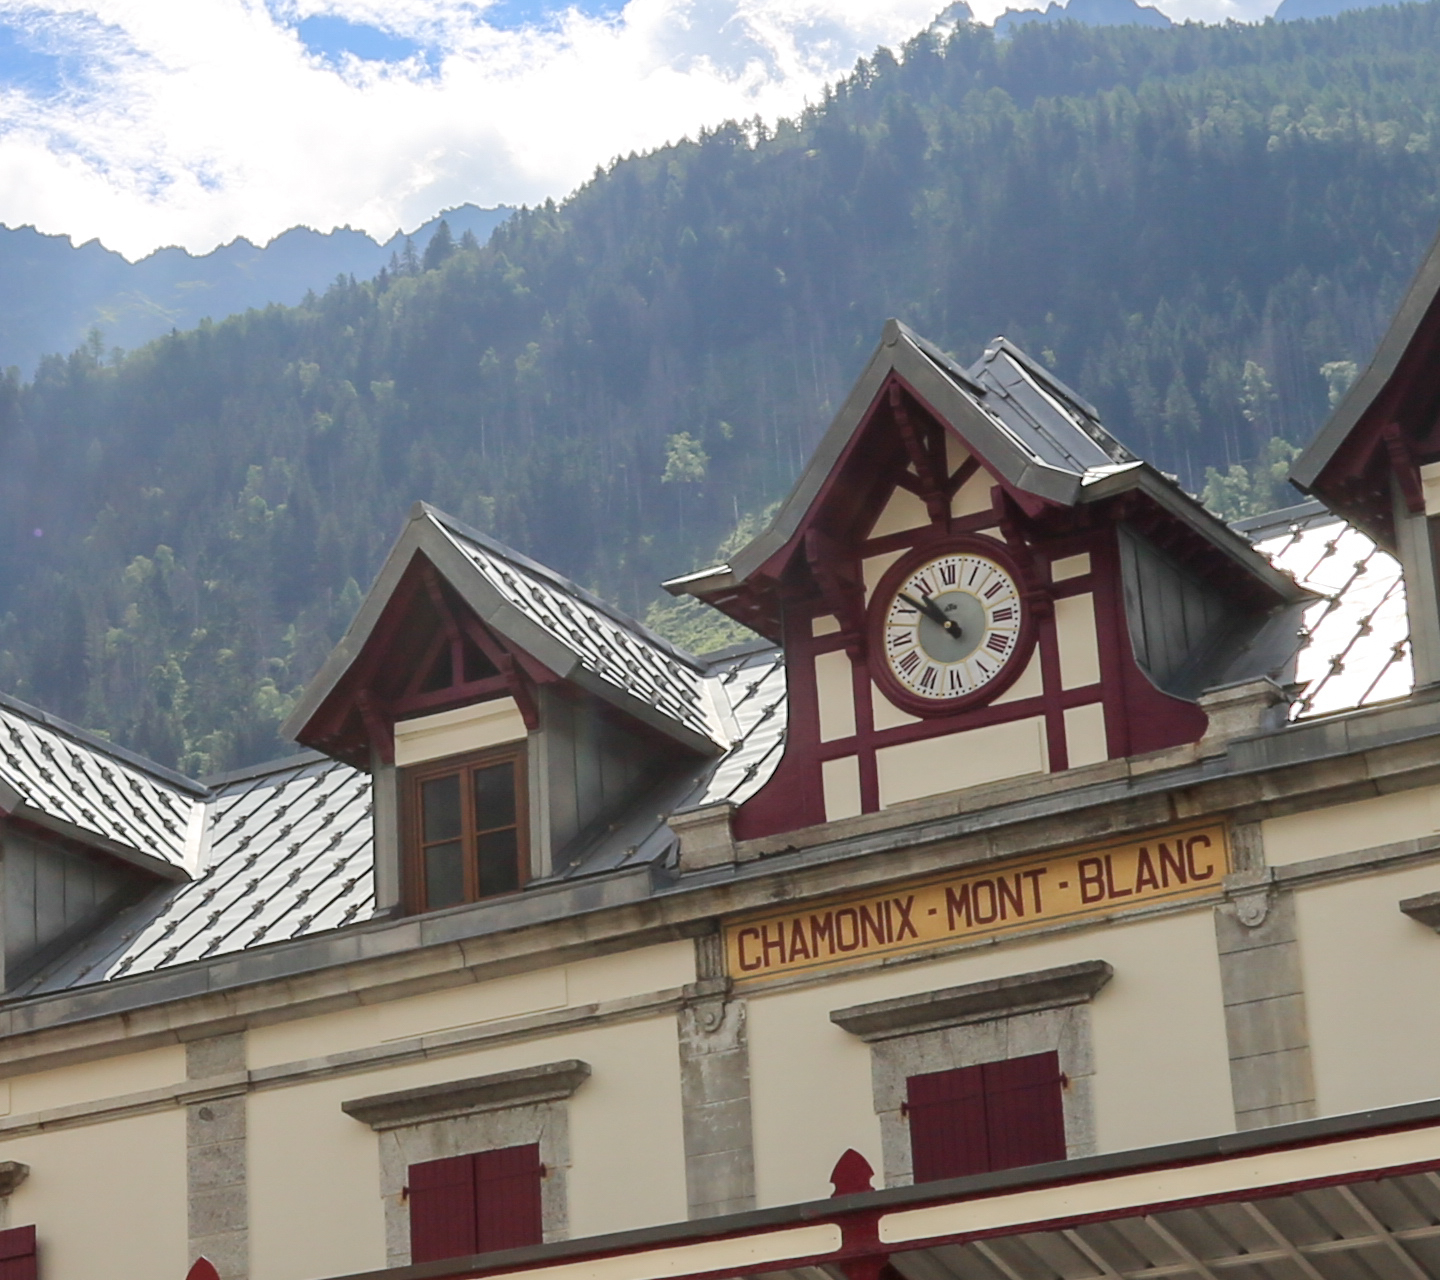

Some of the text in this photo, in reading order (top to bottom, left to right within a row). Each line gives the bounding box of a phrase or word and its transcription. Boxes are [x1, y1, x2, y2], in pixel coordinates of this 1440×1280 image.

[737, 894, 919, 972] CHAMONIX
[945, 867, 1048, 932] MONT
[1077, 833, 1215, 905] BLANC
